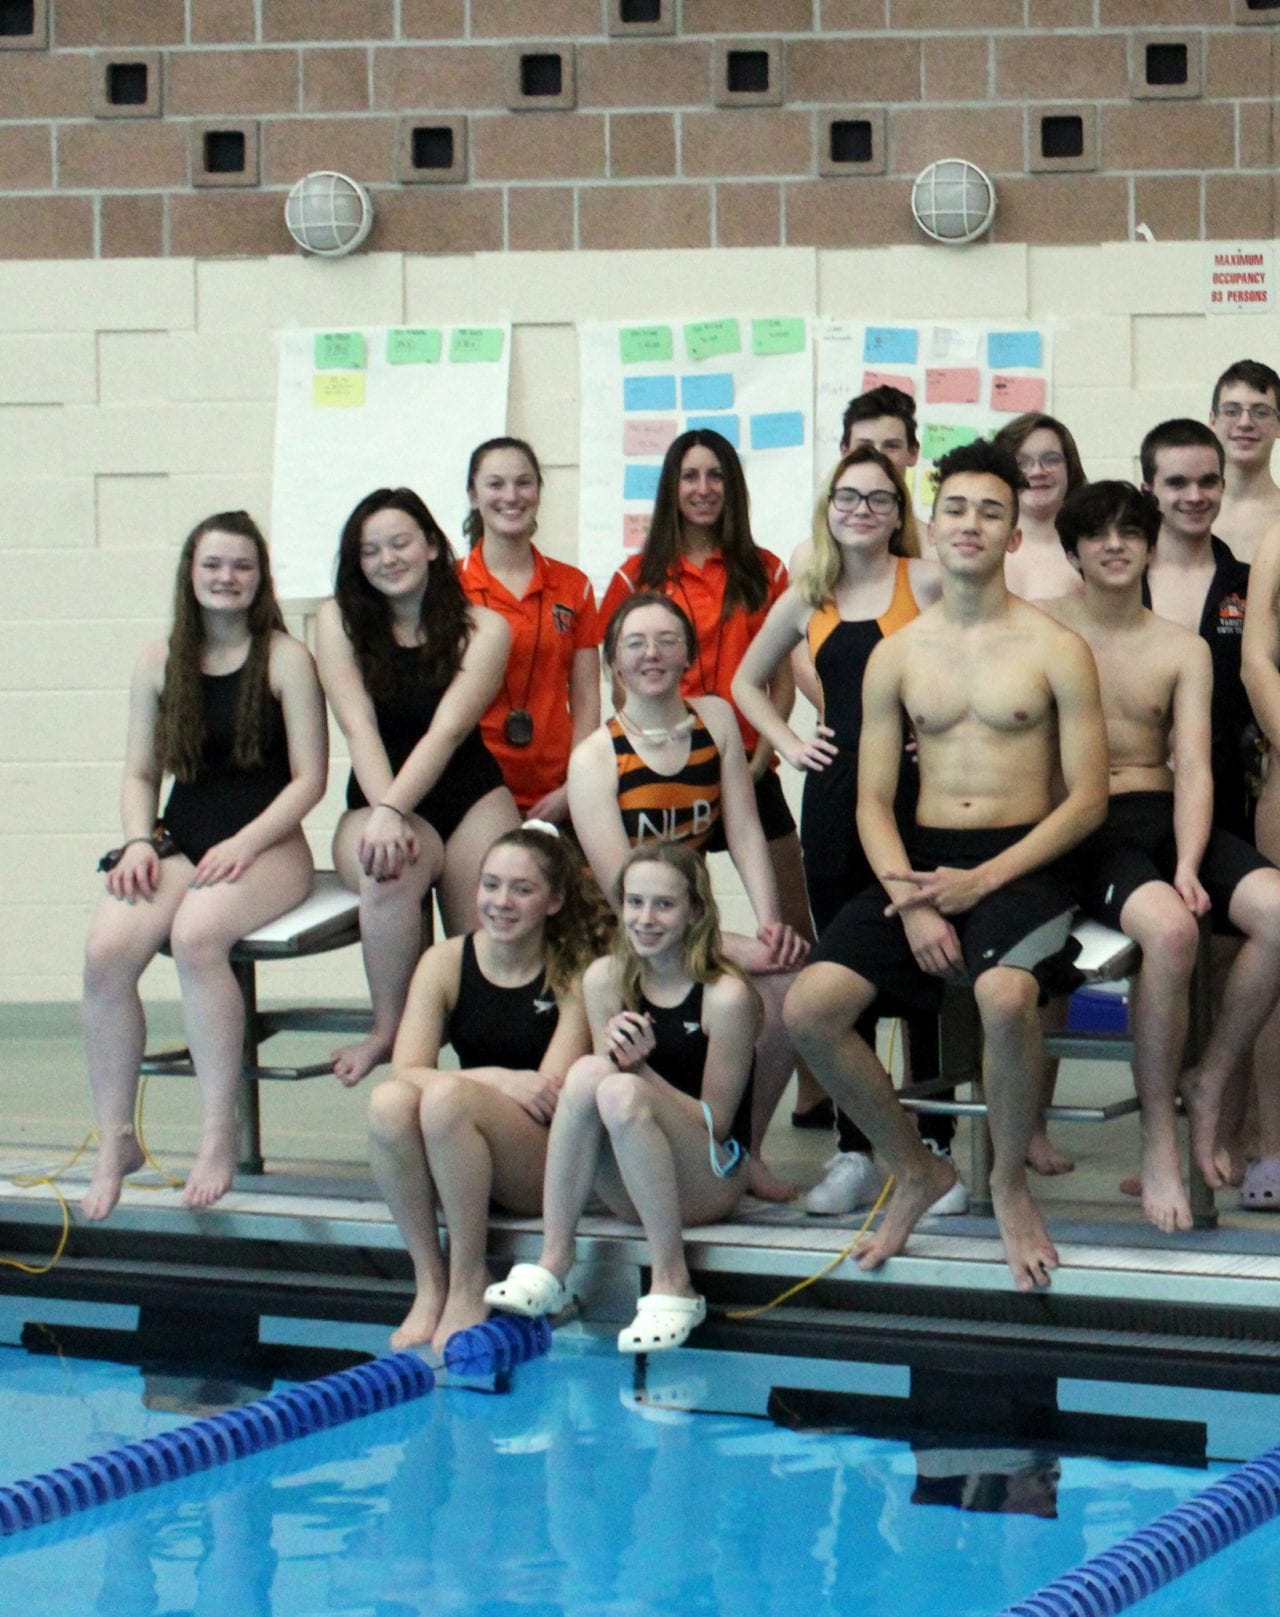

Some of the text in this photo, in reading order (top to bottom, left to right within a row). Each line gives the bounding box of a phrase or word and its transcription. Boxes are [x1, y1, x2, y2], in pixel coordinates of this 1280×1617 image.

[1214, 253, 1264, 266] MAXIMUM
[1212, 272, 1265, 285] OCCUPANCY
[1227, 290, 1268, 303] PERSONS
[638, 798, 712, 846] NLB
